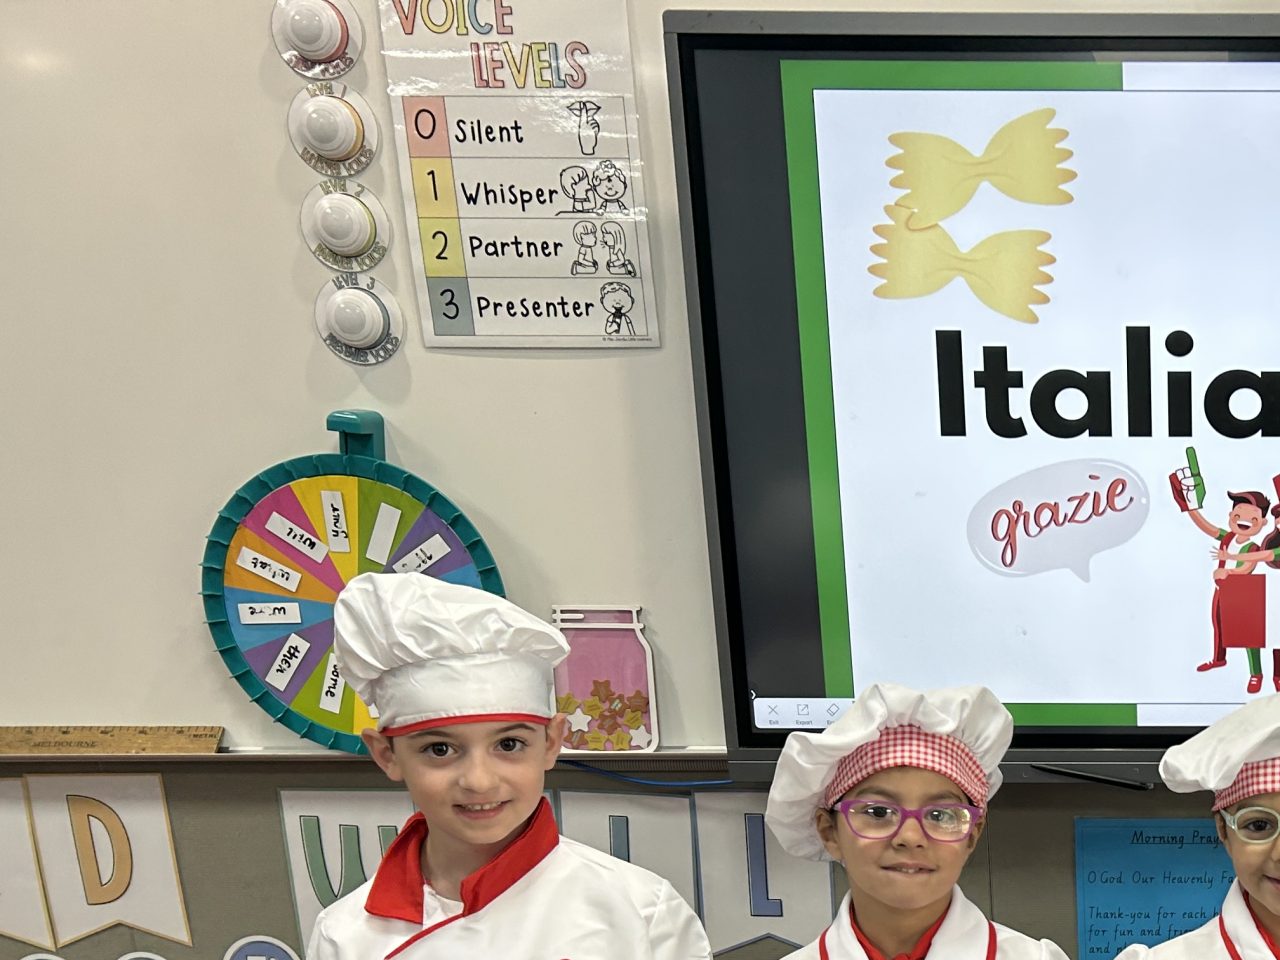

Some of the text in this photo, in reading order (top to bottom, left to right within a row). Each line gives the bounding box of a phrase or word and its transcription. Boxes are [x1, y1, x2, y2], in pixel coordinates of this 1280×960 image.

[391, 0, 513, 35] VOICE
[471, 41, 590, 89] LEVELS
[415, 109, 524, 145] 0 Silent
[427, 170, 559, 212] 1 Whisper
[432, 230, 564, 261] 2 Partner
[440, 288, 595, 320] 3 Presenter
[989, 473, 1136, 569] grazie
[1131, 830, 1220, 849] Morning Pray
[1088, 871, 1096, 884] O
[1132, 871, 1155, 884] Our
[1163, 871, 1214, 889] Heavenly
[1089, 906, 1150, 924] Thank-you
[1157, 906, 1176, 923] for
[1182, 906, 1206, 919] each
[1088, 925, 1109, 942] for
[1114, 925, 1133, 942] fun
[1140, 925, 1161, 937] and
[1089, 942, 1110, 954] and
